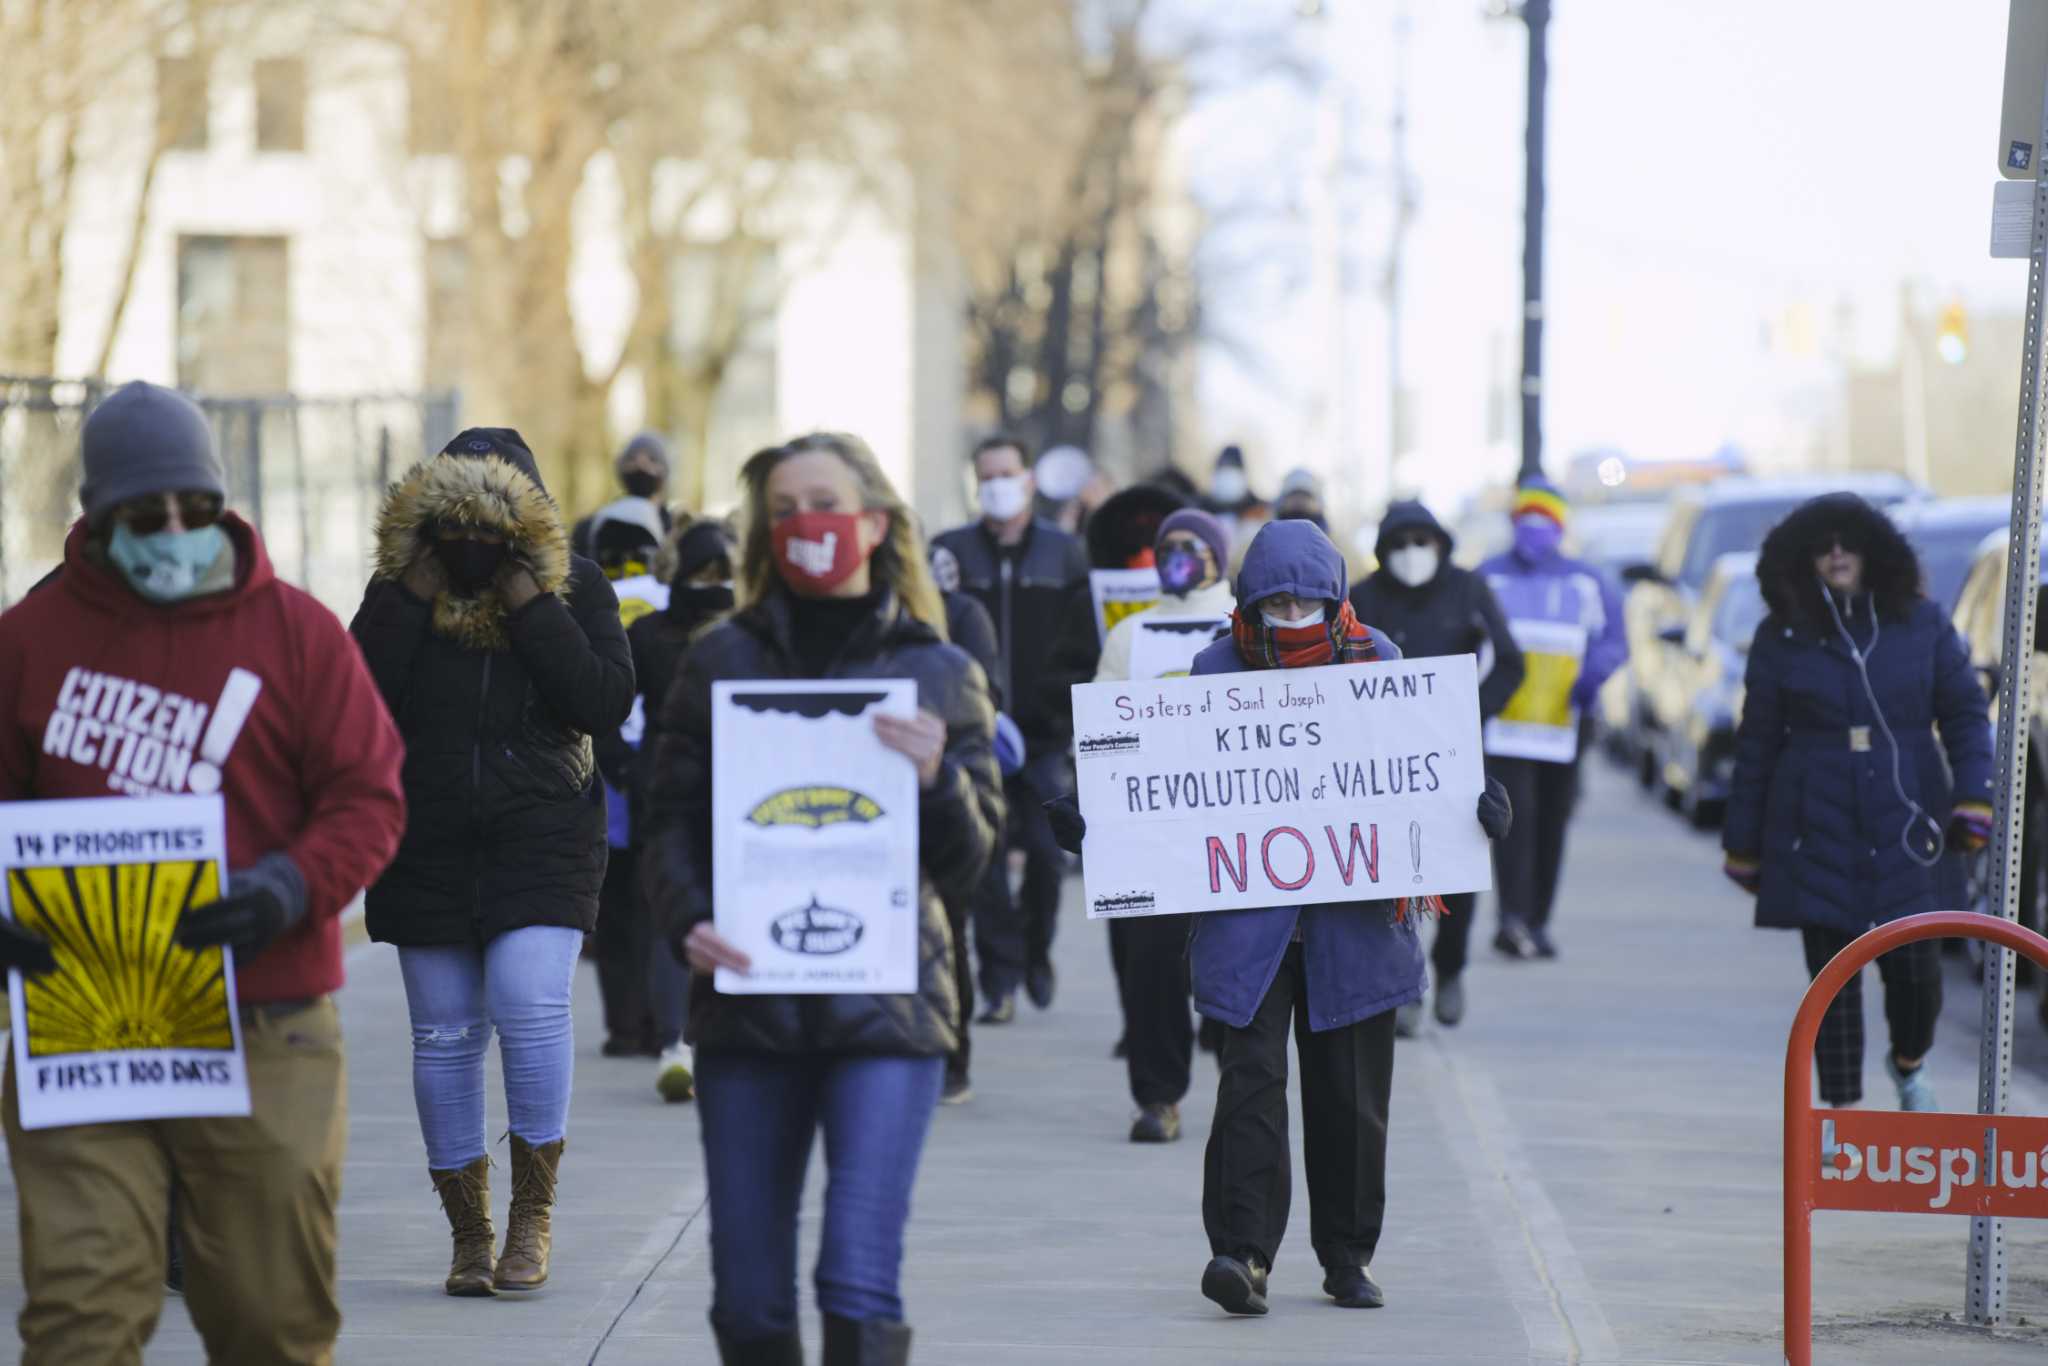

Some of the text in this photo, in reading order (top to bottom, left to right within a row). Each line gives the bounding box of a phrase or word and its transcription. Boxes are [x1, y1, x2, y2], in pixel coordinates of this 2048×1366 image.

[57, 666, 208, 749] CITIZEN
[1115, 673, 1436, 721] Sisters of Saint Joseph WANT
[1216, 722, 1321, 752] KING'S
[15, 829, 203, 858] 14 PRIORITIES
[38, 1061, 119, 1090] FIRST
[172, 1058, 230, 1085] DAYS
[1821, 1119, 2048, 1208] busplu
